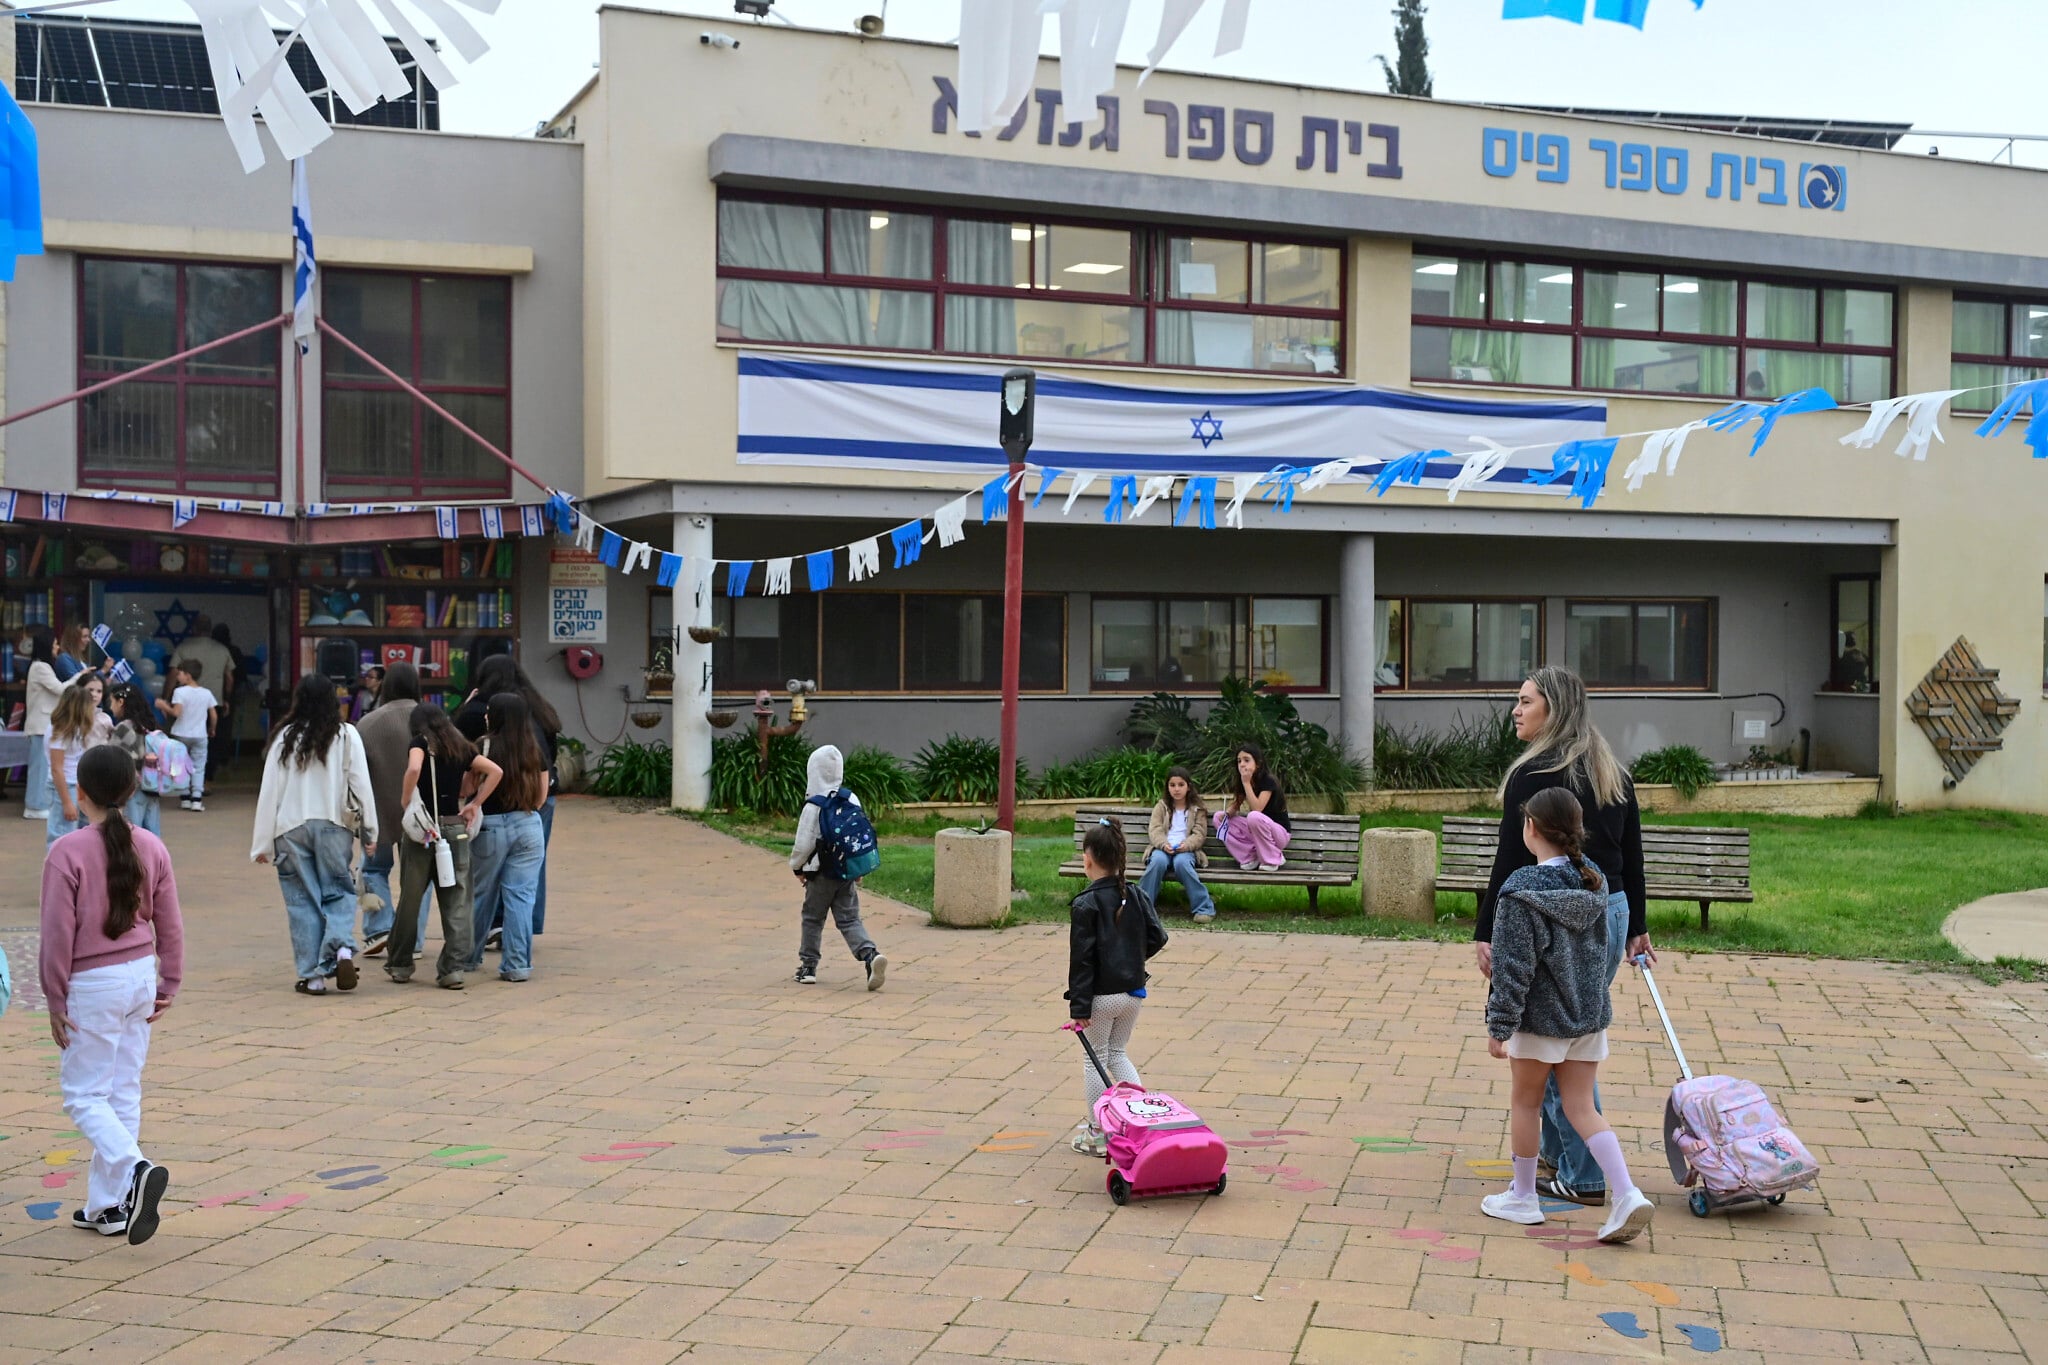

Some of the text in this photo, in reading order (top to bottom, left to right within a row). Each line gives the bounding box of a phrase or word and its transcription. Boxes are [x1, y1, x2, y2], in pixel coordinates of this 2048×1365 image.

[1144, 99, 1274, 166] ספר
[1295, 115, 1403, 180] בית
[1482, 126, 1788, 206] בית ספר פיס
[554, 589, 588, 599] דברים
[554, 599, 585, 609] טובים
[554, 607, 602, 620] מתחילים
[577, 621, 596, 632] כאן
